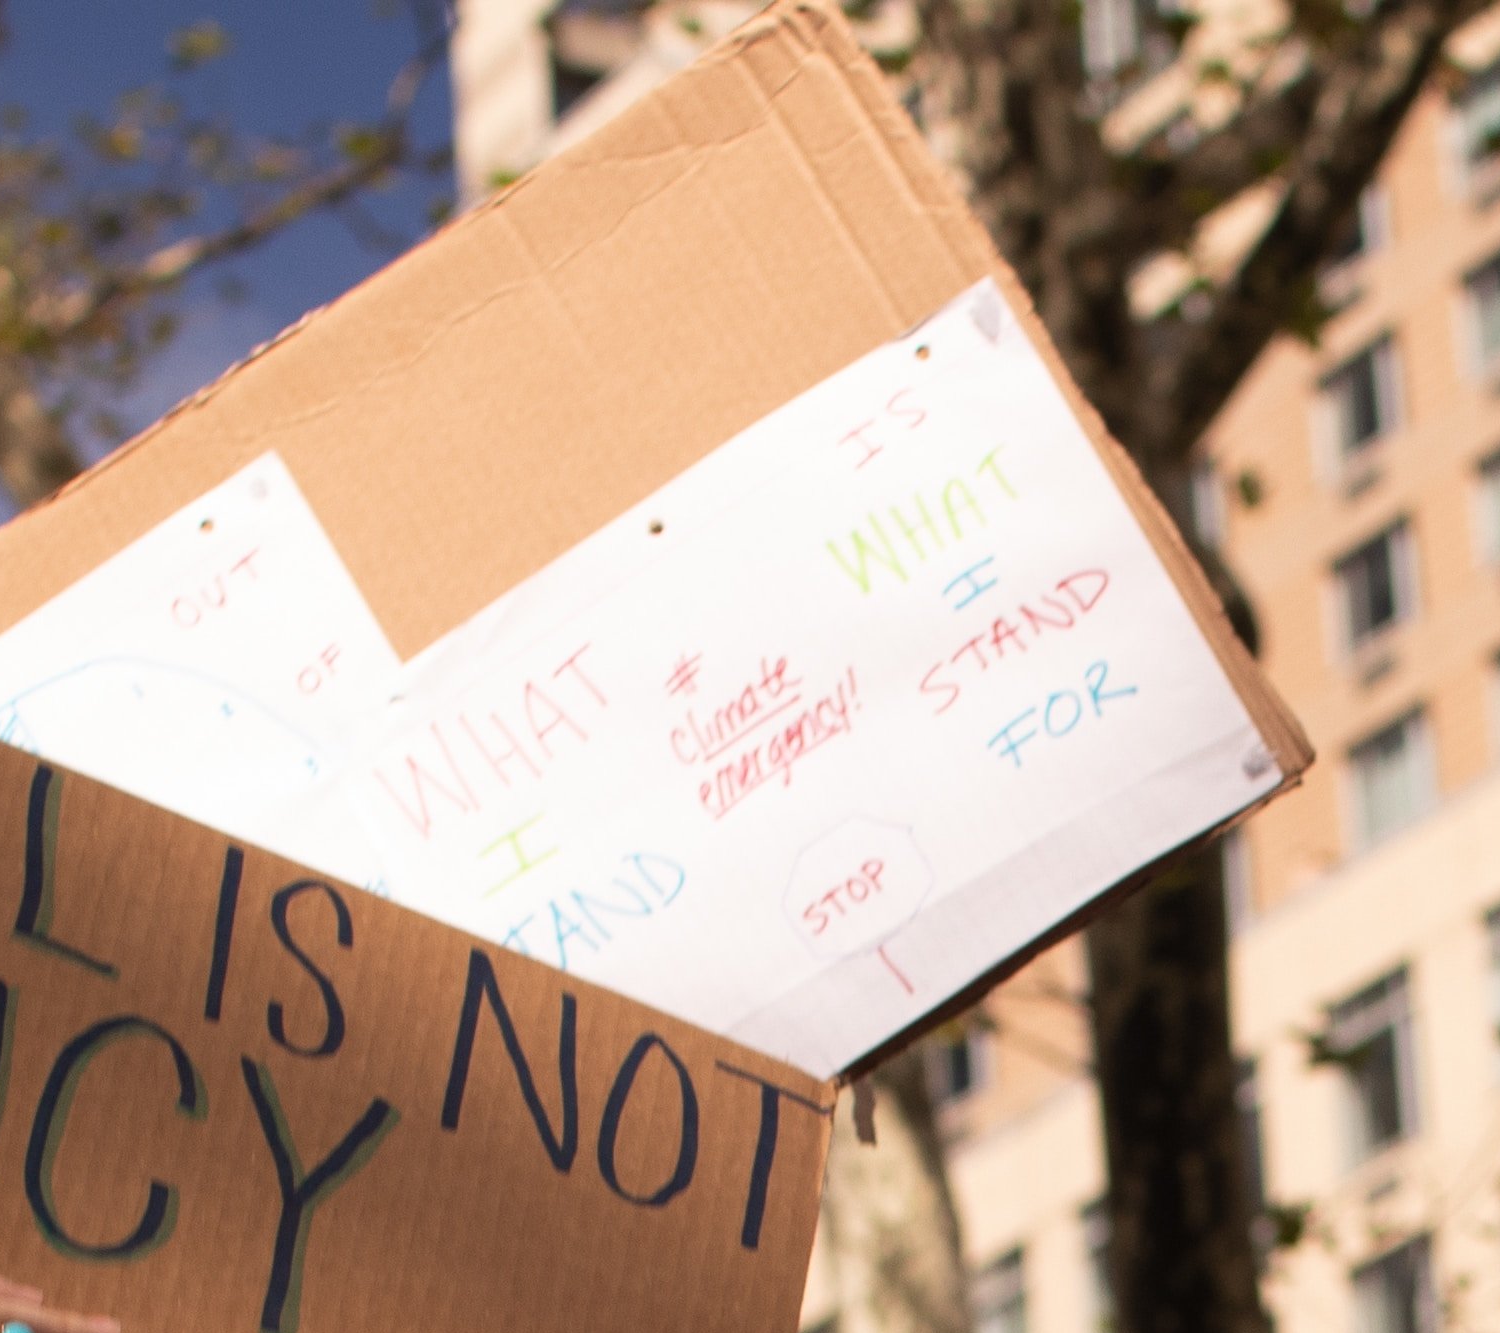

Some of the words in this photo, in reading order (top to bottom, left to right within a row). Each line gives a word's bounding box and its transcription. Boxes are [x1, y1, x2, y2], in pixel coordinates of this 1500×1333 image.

[838, 388, 927, 469] IS
[824, 443, 1020, 595] WHAT
[171, 548, 259, 630] OUT
[919, 568, 1110, 715] STAND
[296, 642, 342, 696] OF
[987, 660, 1139, 768] FOR
[373, 643, 610, 840] WHAT
[498, 852, 685, 971] TAND
[802, 857, 886, 936] STOP
[203, 844, 355, 1057] IS
[440, 946, 834, 1250] NOT
